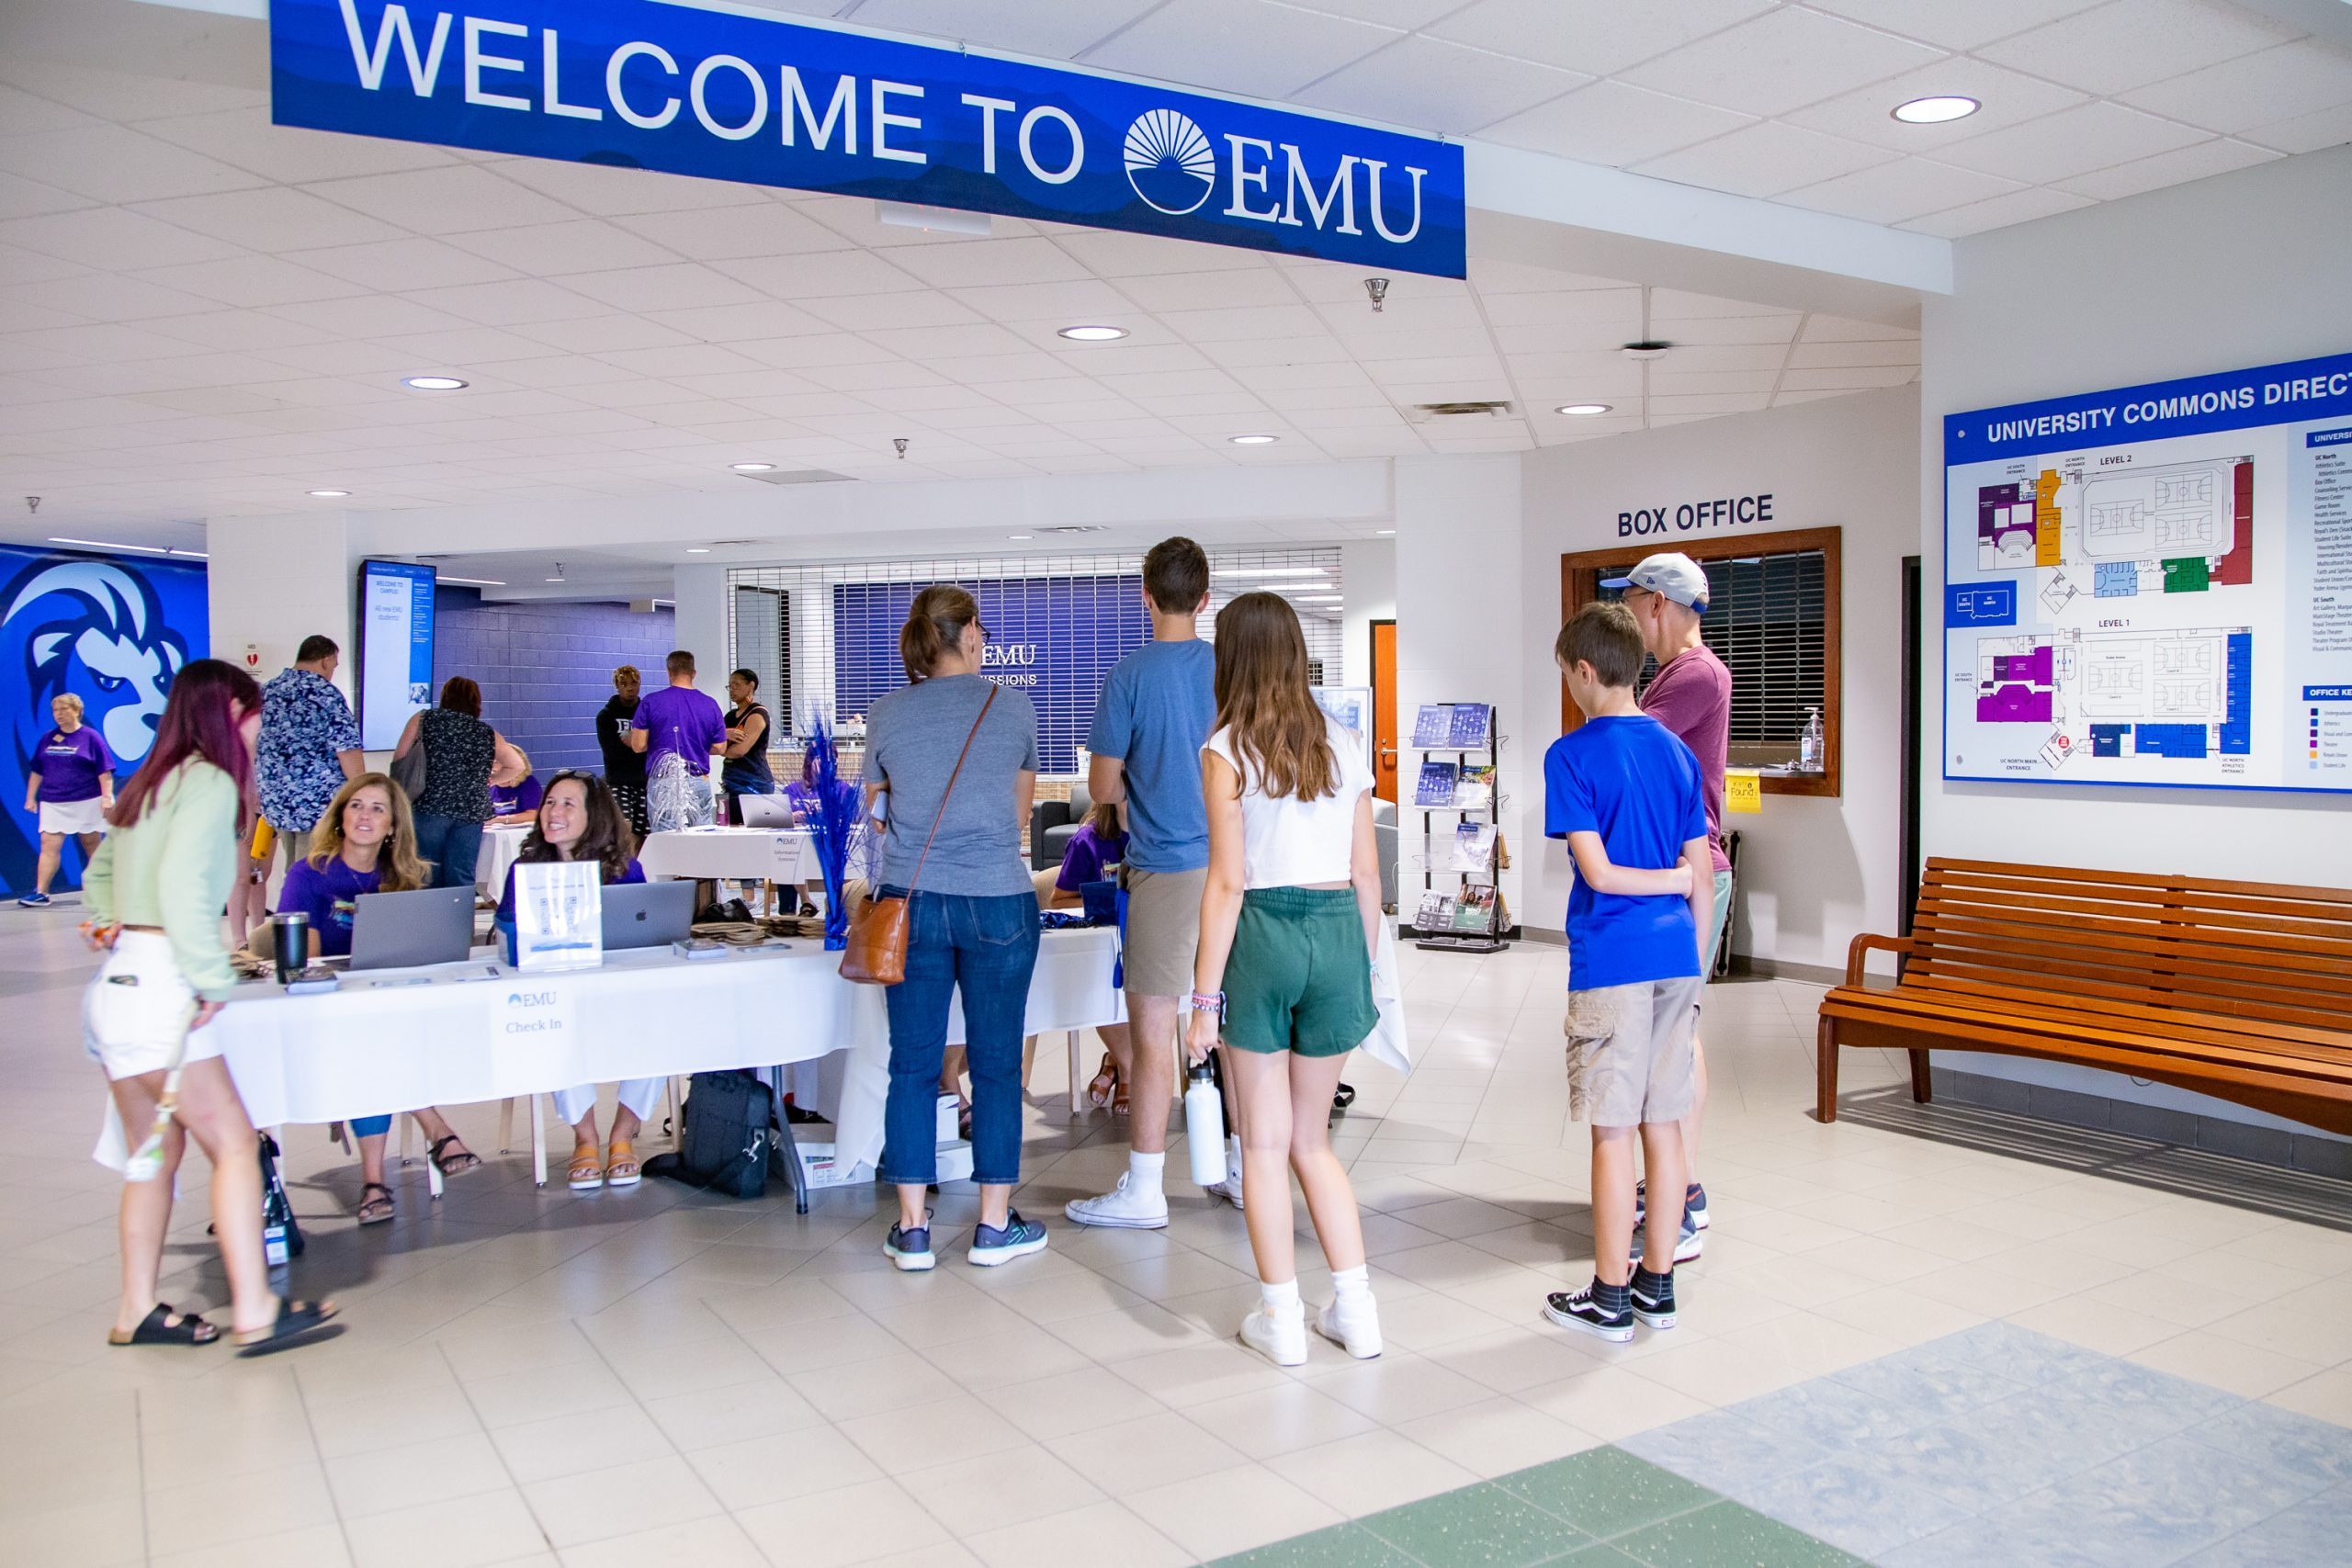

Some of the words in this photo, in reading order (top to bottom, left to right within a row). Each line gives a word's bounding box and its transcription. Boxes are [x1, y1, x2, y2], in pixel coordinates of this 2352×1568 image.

[338, 0, 927, 164] WELCOME
[961, 93, 1084, 185] TO
[1223, 132, 1428, 243] EMU
[1987, 406, 2116, 443] UNIVERSITY
[2123, 386, 2255, 424] COMMONS
[2314, 432, 2352, 443] UNIVERSI
[2100, 456, 2125, 466] LEVEL
[2127, 455, 2132, 463] 2
[1618, 507, 1668, 537] BOX
[1676, 494, 1773, 531] OFFICE
[2098, 619, 2124, 627] LEVEL
[980, 645, 1037, 666] EMU
[523, 992, 558, 1008] EMU
[506, 1019, 546, 1034] Check
[549, 1018, 562, 1030] In
